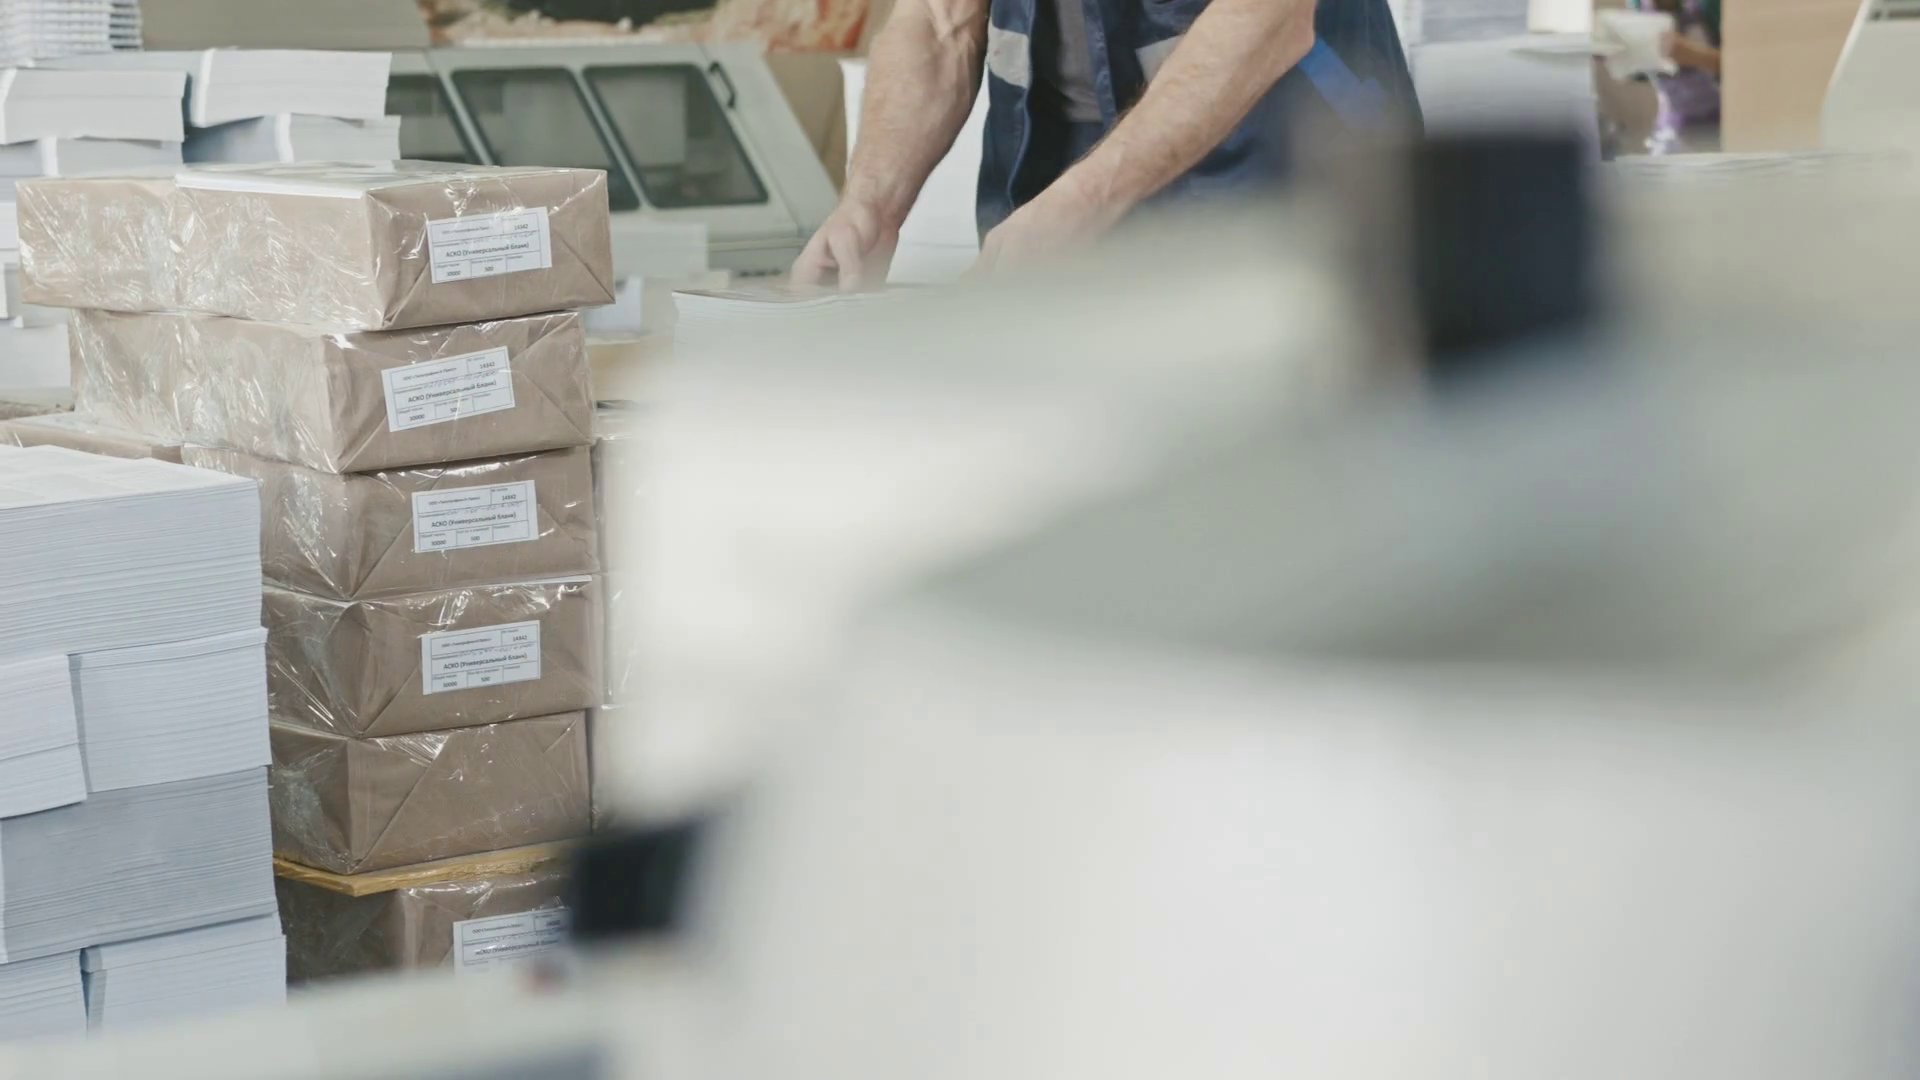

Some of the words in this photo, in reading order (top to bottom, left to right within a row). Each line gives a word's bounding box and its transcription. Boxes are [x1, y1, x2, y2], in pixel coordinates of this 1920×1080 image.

[446, 250, 462, 258] АСКО
[462, 244, 510, 257] (Универсальный
[510, 242, 530, 250] бланк)
[408, 394, 425, 403] АСКО
[426, 384, 476, 400] (Универсальный
[476, 380, 497, 389] бланк)
[431, 520, 448, 528] АСКО
[448, 514, 497, 526] (Универсальный
[497, 512, 516, 520] бланк)
[443, 662, 459, 670] АСКО
[460, 655, 507, 669] (Универсальный
[508, 652, 527, 660] бланк)
